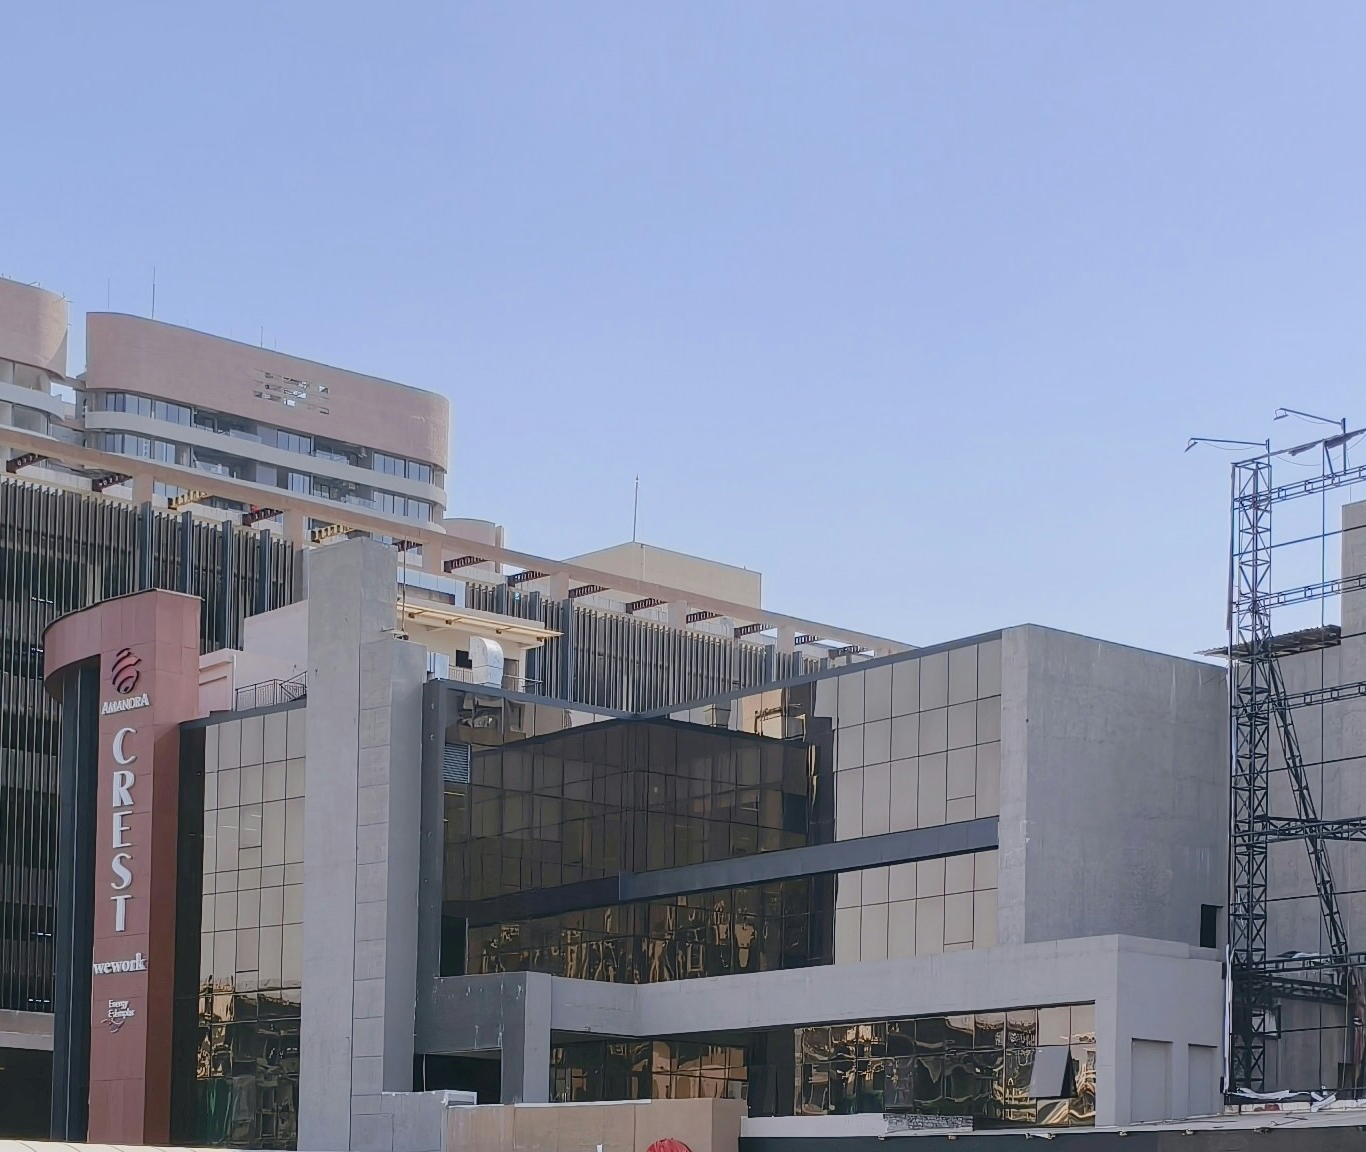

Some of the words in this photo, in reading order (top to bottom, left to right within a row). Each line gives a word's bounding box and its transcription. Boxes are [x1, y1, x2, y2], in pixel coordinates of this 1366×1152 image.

[102, 693, 150, 715] AMANORA
[110, 727, 137, 933] CREST
[93, 953, 147, 975] wework
